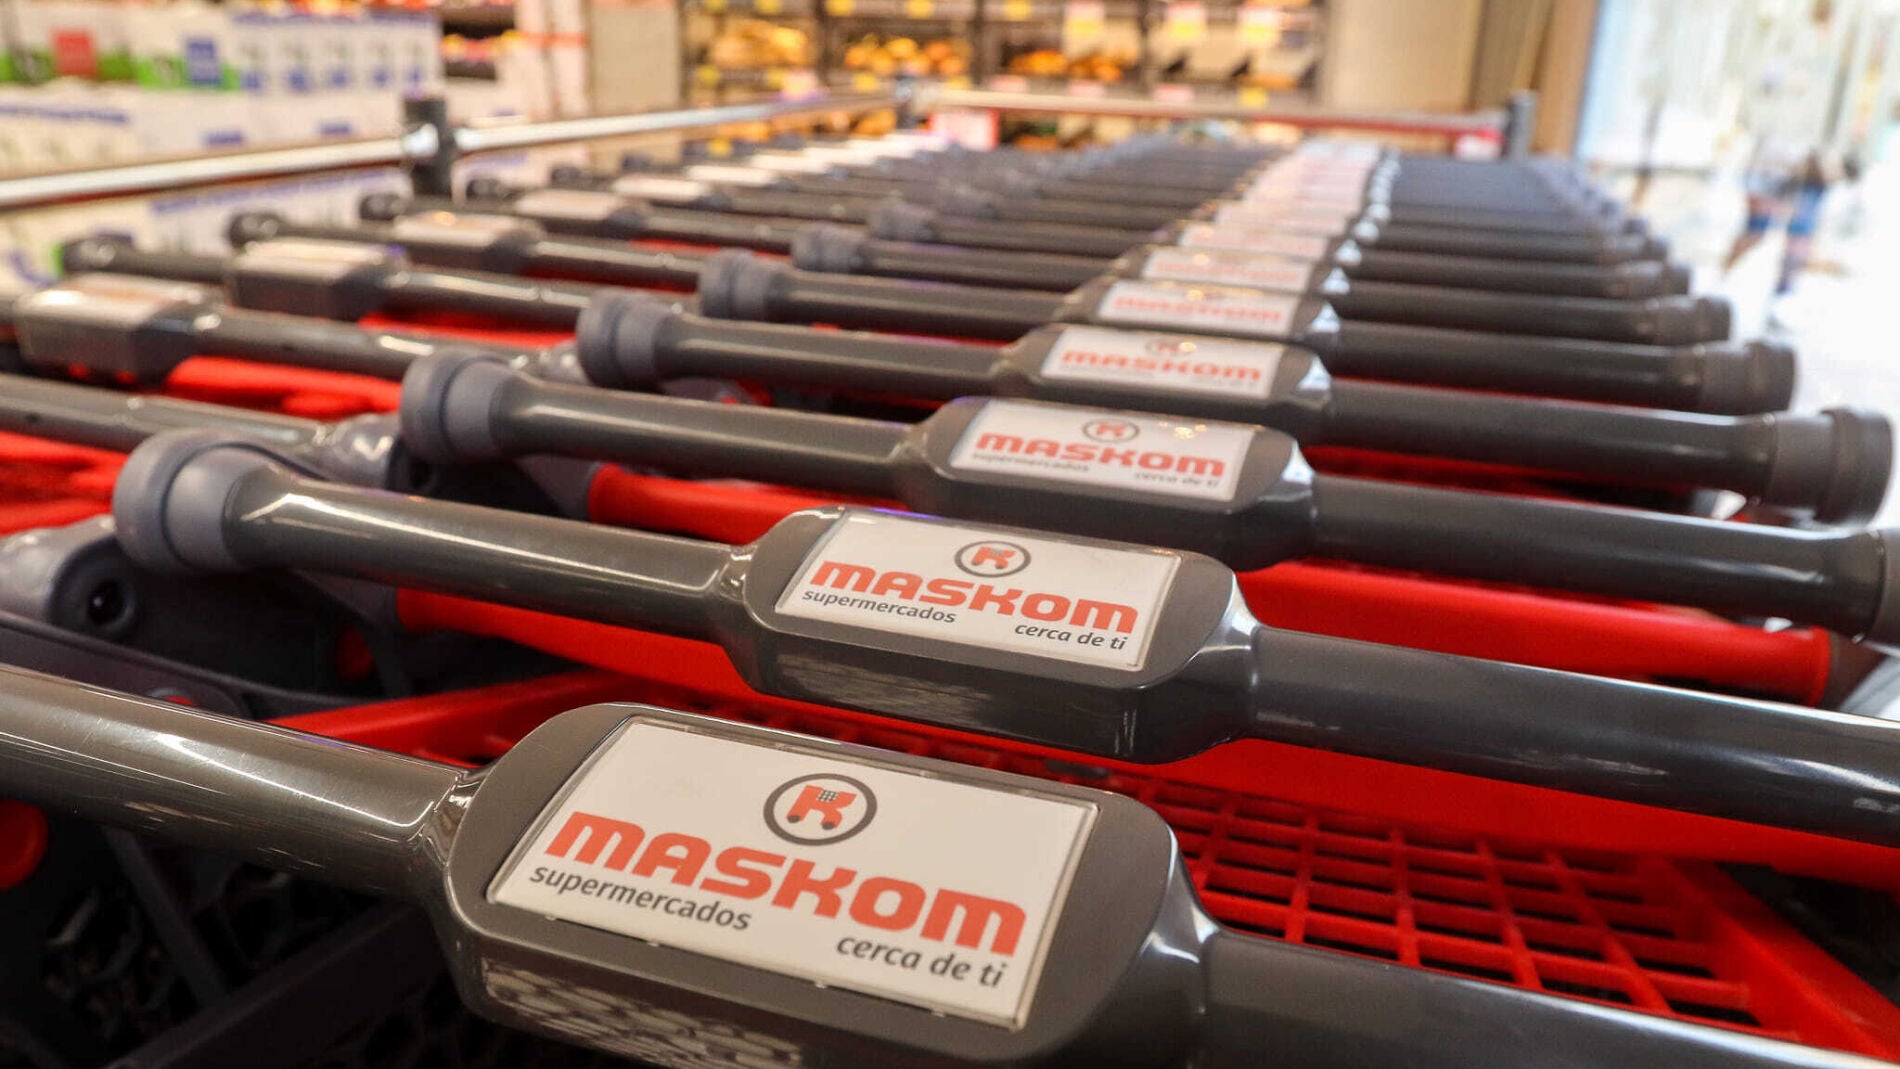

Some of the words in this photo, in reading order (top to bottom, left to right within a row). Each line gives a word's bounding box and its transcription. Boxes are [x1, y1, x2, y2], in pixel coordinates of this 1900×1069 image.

[975, 432, 1226, 478] MASKOM
[802, 588, 957, 624] supermercados
[809, 560, 1139, 634] MASKOM
[1014, 622, 1071, 643] cerca
[1076, 630, 1105, 648] de
[1111, 636, 1129, 651] ti
[529, 863, 753, 932] supermercados
[543, 810, 1028, 958] MASKOM
[835, 932, 920, 971] cerca
[929, 951, 972, 982] de
[978, 961, 1009, 989] ti
